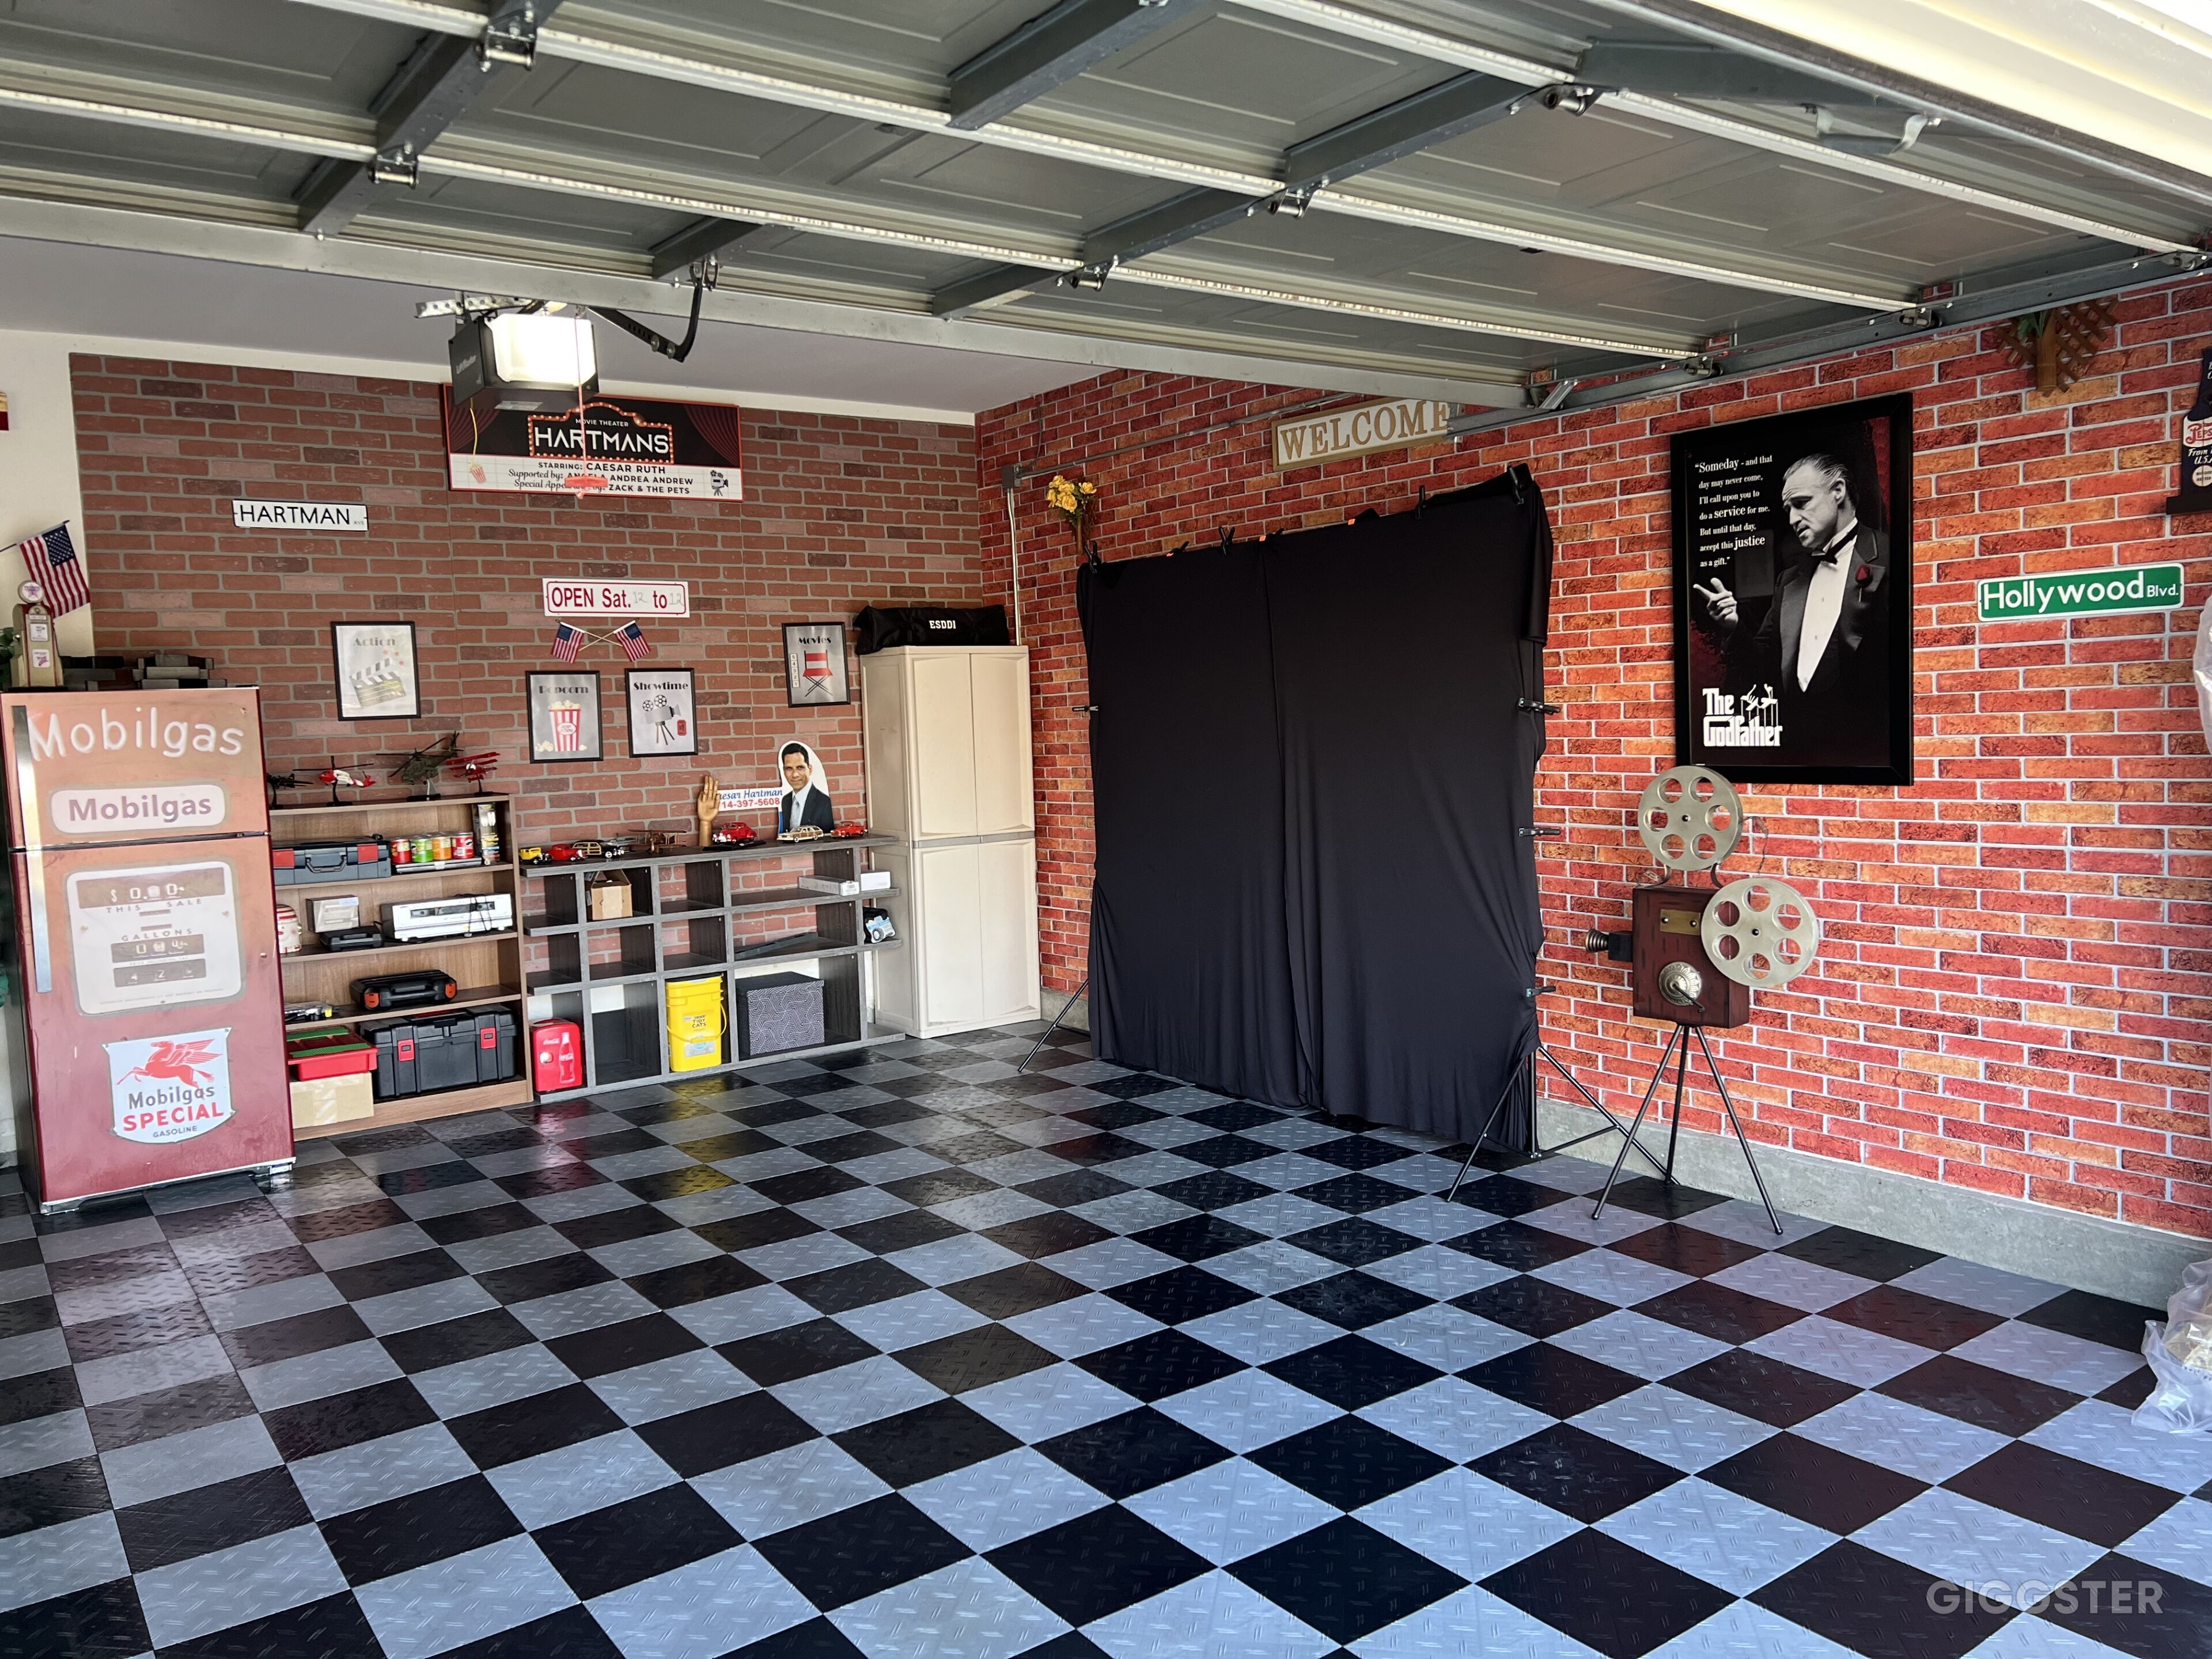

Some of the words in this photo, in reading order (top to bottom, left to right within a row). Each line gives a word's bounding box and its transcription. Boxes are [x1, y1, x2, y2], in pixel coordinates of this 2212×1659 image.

[1280, 400, 1449, 460] WELCOME
[535, 427, 669, 453] HARTMANS
[2188, 448, 2207, 456] From
[538, 462, 582, 470] STARRING:
[586, 463, 631, 472] CAESAR
[637, 465, 665, 474] RUTH
[1695, 458, 1739, 473] “Someday
[1745, 456, 1758, 465] and
[1759, 455, 1772, 464] that
[509, 468, 548, 480] Supported
[551, 470, 563, 481] by:
[610, 475, 649, 483] ANDREA
[514, 479, 543, 490] Special
[1699, 481, 1710, 490] day
[1725, 477, 1743, 485] never
[1699, 496, 1708, 505] I'll
[1710, 494, 1721, 503] call
[1722, 494, 1738, 503] upon
[1740, 492, 1751, 501] you
[240, 505, 350, 525] HARTMAN
[1699, 512, 1707, 520] do
[1714, 506, 1745, 518] service
[1747, 506, 1757, 514] for
[1700, 528, 1711, 536] But
[1713, 525, 1728, 534] until
[1729, 524, 1742, 532] that
[1744, 522, 1756, 532] day,
[1700, 543, 1719, 552] accept
[1721, 541, 1733, 549] this
[1734, 535, 1765, 551] justice
[552, 587, 594, 607] OPEN
[602, 588, 631, 608] Sat.
[653, 590, 667, 608] to
[1983, 571, 2144, 613] Hollywood
[2147, 584, 2179, 598] Blvd.
[929, 620, 956, 629] ESDDI
[354, 637, 395, 646] Action
[799, 636, 831, 644] Movies
[539, 685, 589, 694] Popcorn
[634, 682, 688, 690] Showtime
[1702, 688, 1734, 715] The
[28, 706, 244, 762] Mobilgas
[1703, 715, 1783, 747] Godfather
[744, 789, 783, 798] Hartman
[69, 794, 211, 823] Mobilgas
[721, 797, 780, 808] 14-397-5608
[106, 904, 141, 914] THIS
[167, 898, 202, 907] SALE
[122, 928, 192, 941] GALLONS
[128, 1086, 215, 1109] Mobilgas
[123, 1102, 224, 1132] SPECIAL
[153, 1126, 198, 1138] GASOLINE
